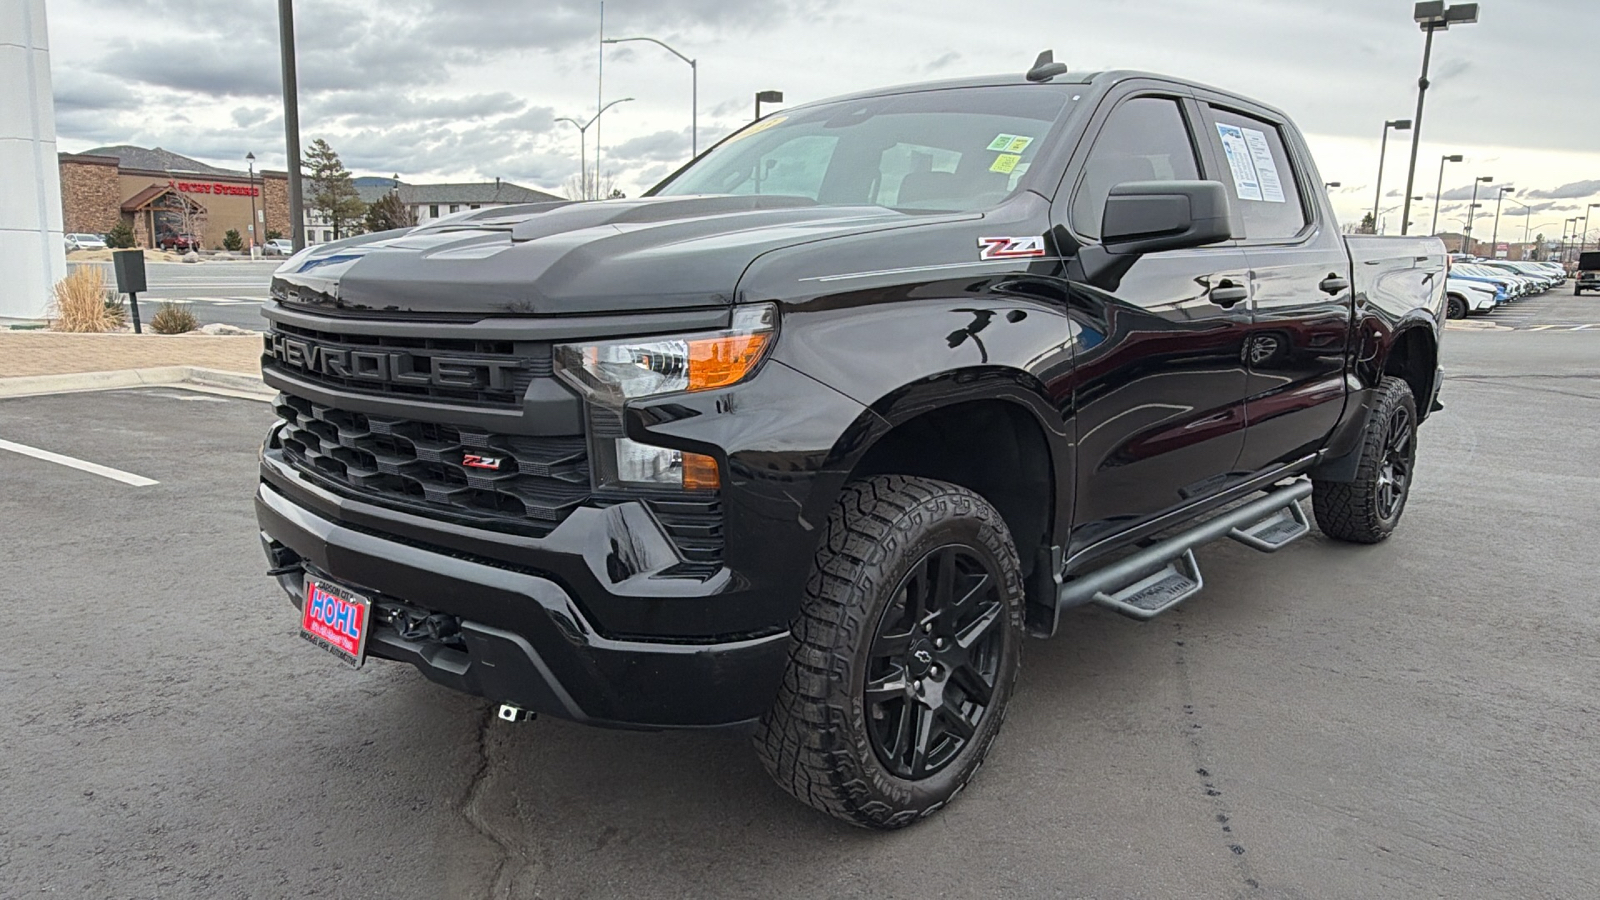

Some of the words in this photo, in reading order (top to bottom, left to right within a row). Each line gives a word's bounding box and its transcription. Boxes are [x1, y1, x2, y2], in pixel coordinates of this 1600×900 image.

[978, 236, 1045, 260] Z71
[264, 332, 529, 392] CHEVROLET
[462, 454, 501, 470] Z71
[310, 588, 359, 639] HOHL
